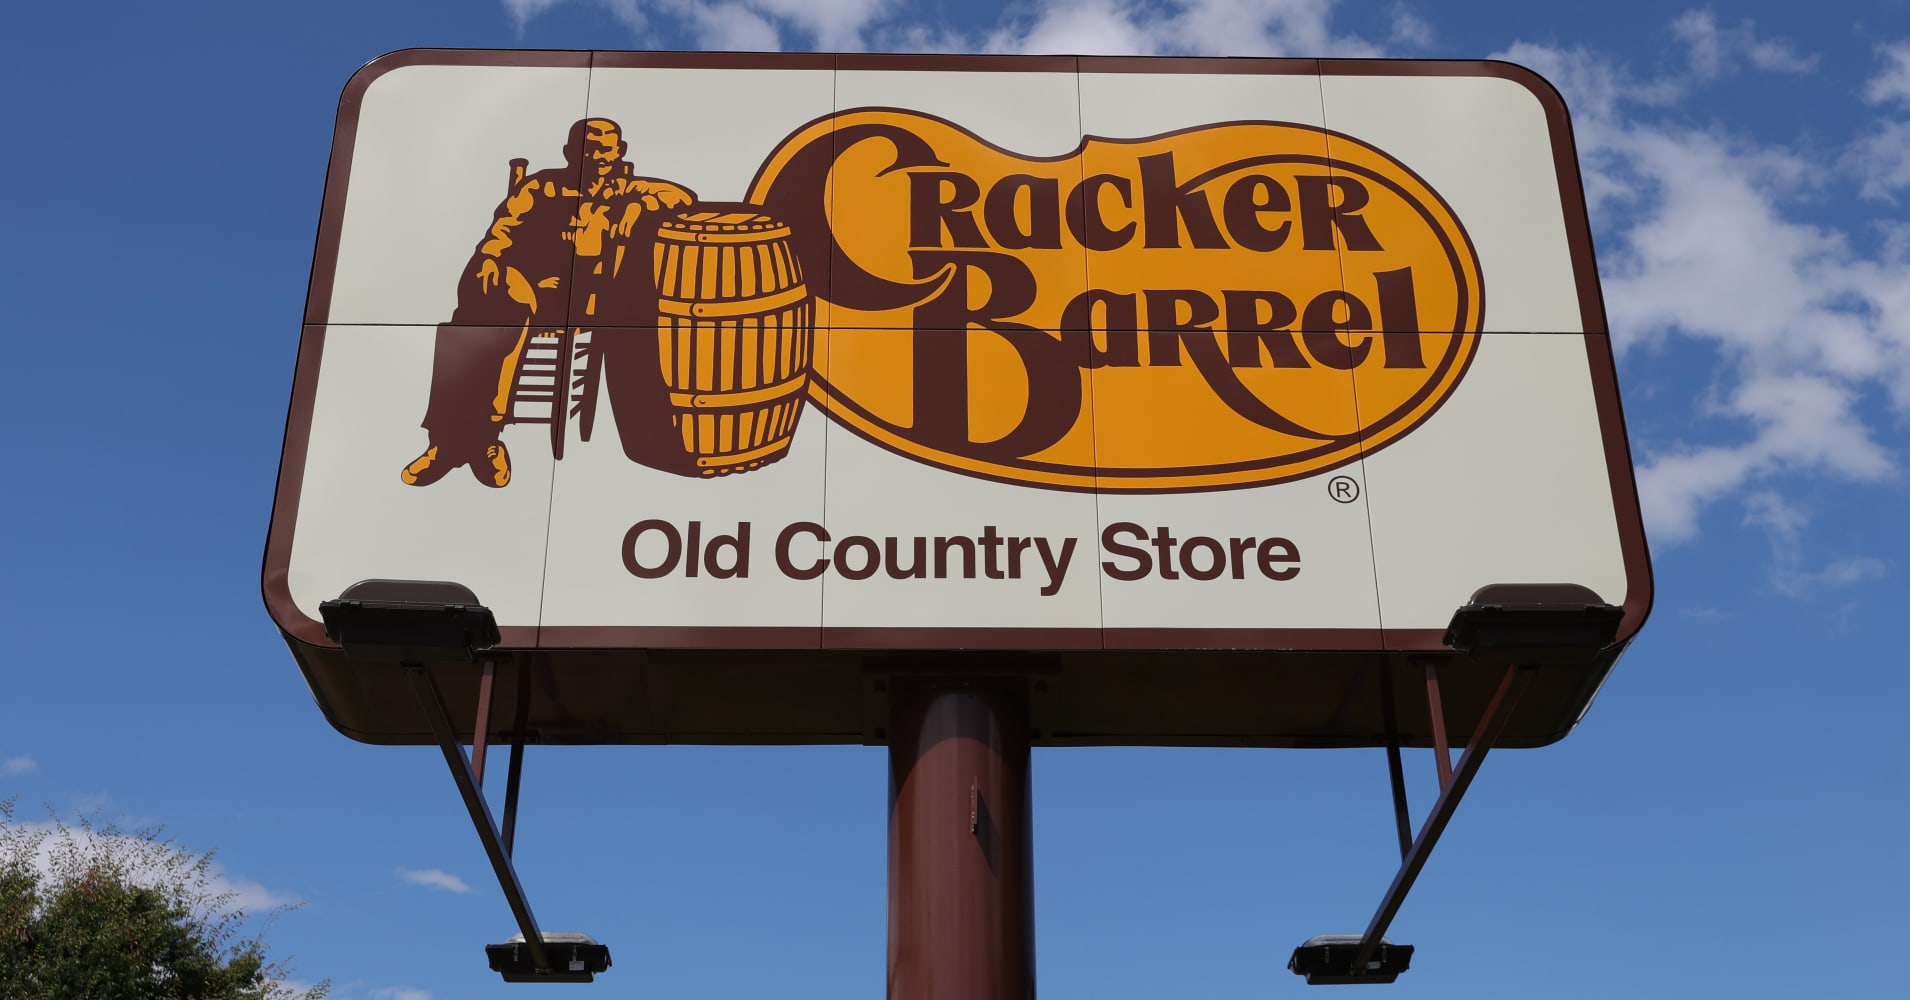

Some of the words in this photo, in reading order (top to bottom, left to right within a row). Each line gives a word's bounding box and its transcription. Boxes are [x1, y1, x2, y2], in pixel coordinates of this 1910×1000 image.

[621, 519, 751, 580] Old
[774, 520, 1078, 597] Country
[1101, 521, 1301, 582] Store
